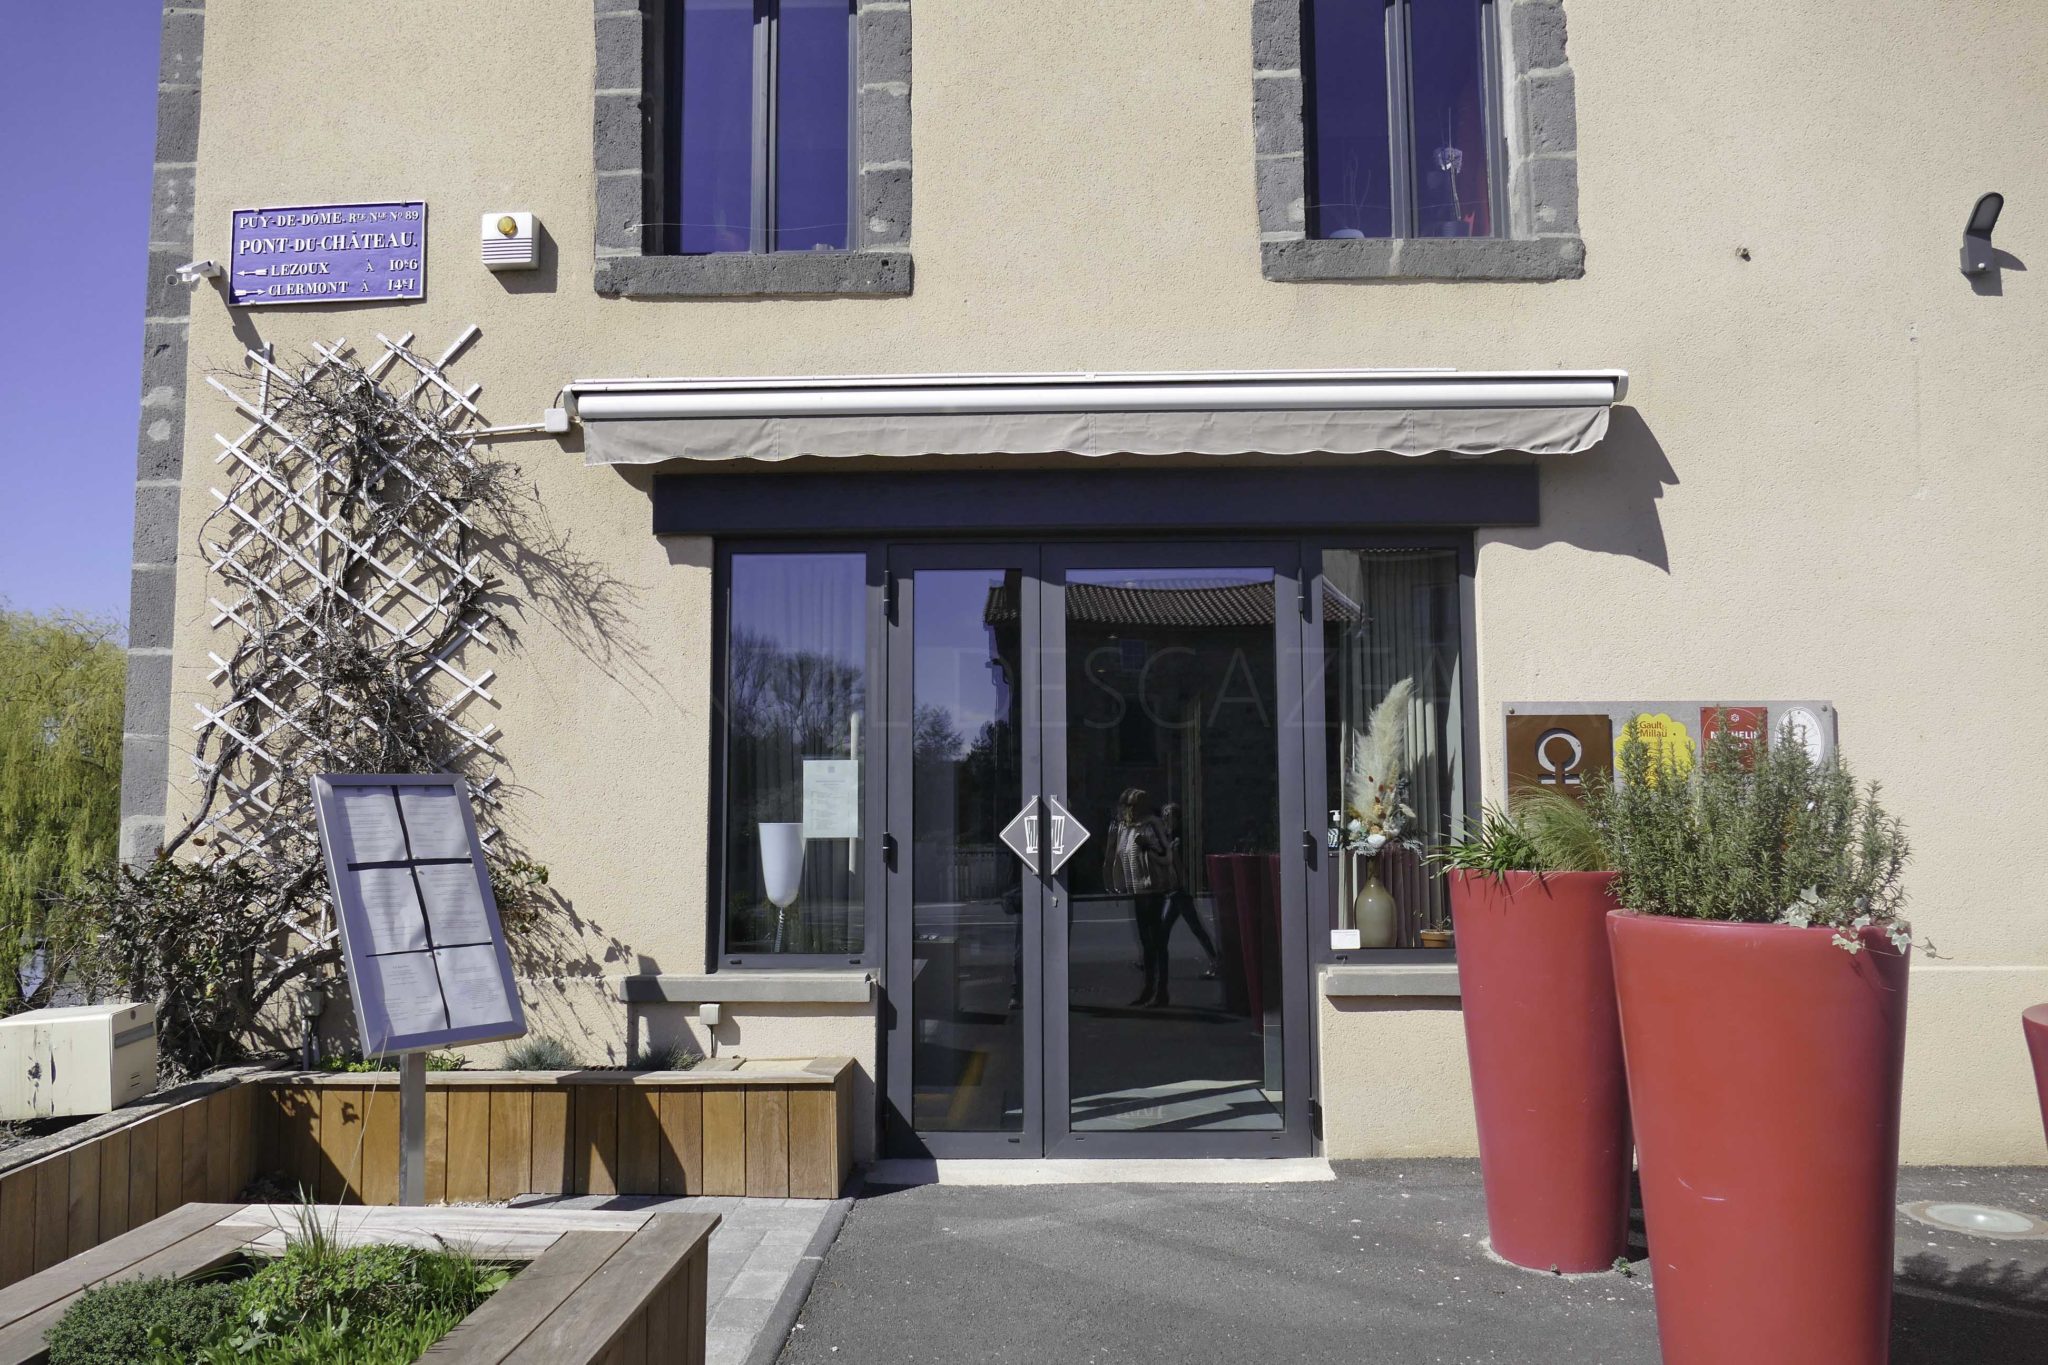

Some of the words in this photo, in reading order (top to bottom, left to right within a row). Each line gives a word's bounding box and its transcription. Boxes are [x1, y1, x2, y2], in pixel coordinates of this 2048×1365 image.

[405, 210, 419, 220] 89
[271, 262, 330, 277] LEZOUX
[268, 281, 349, 297] CLERMONT
[1639, 729, 1668, 738] Millau
